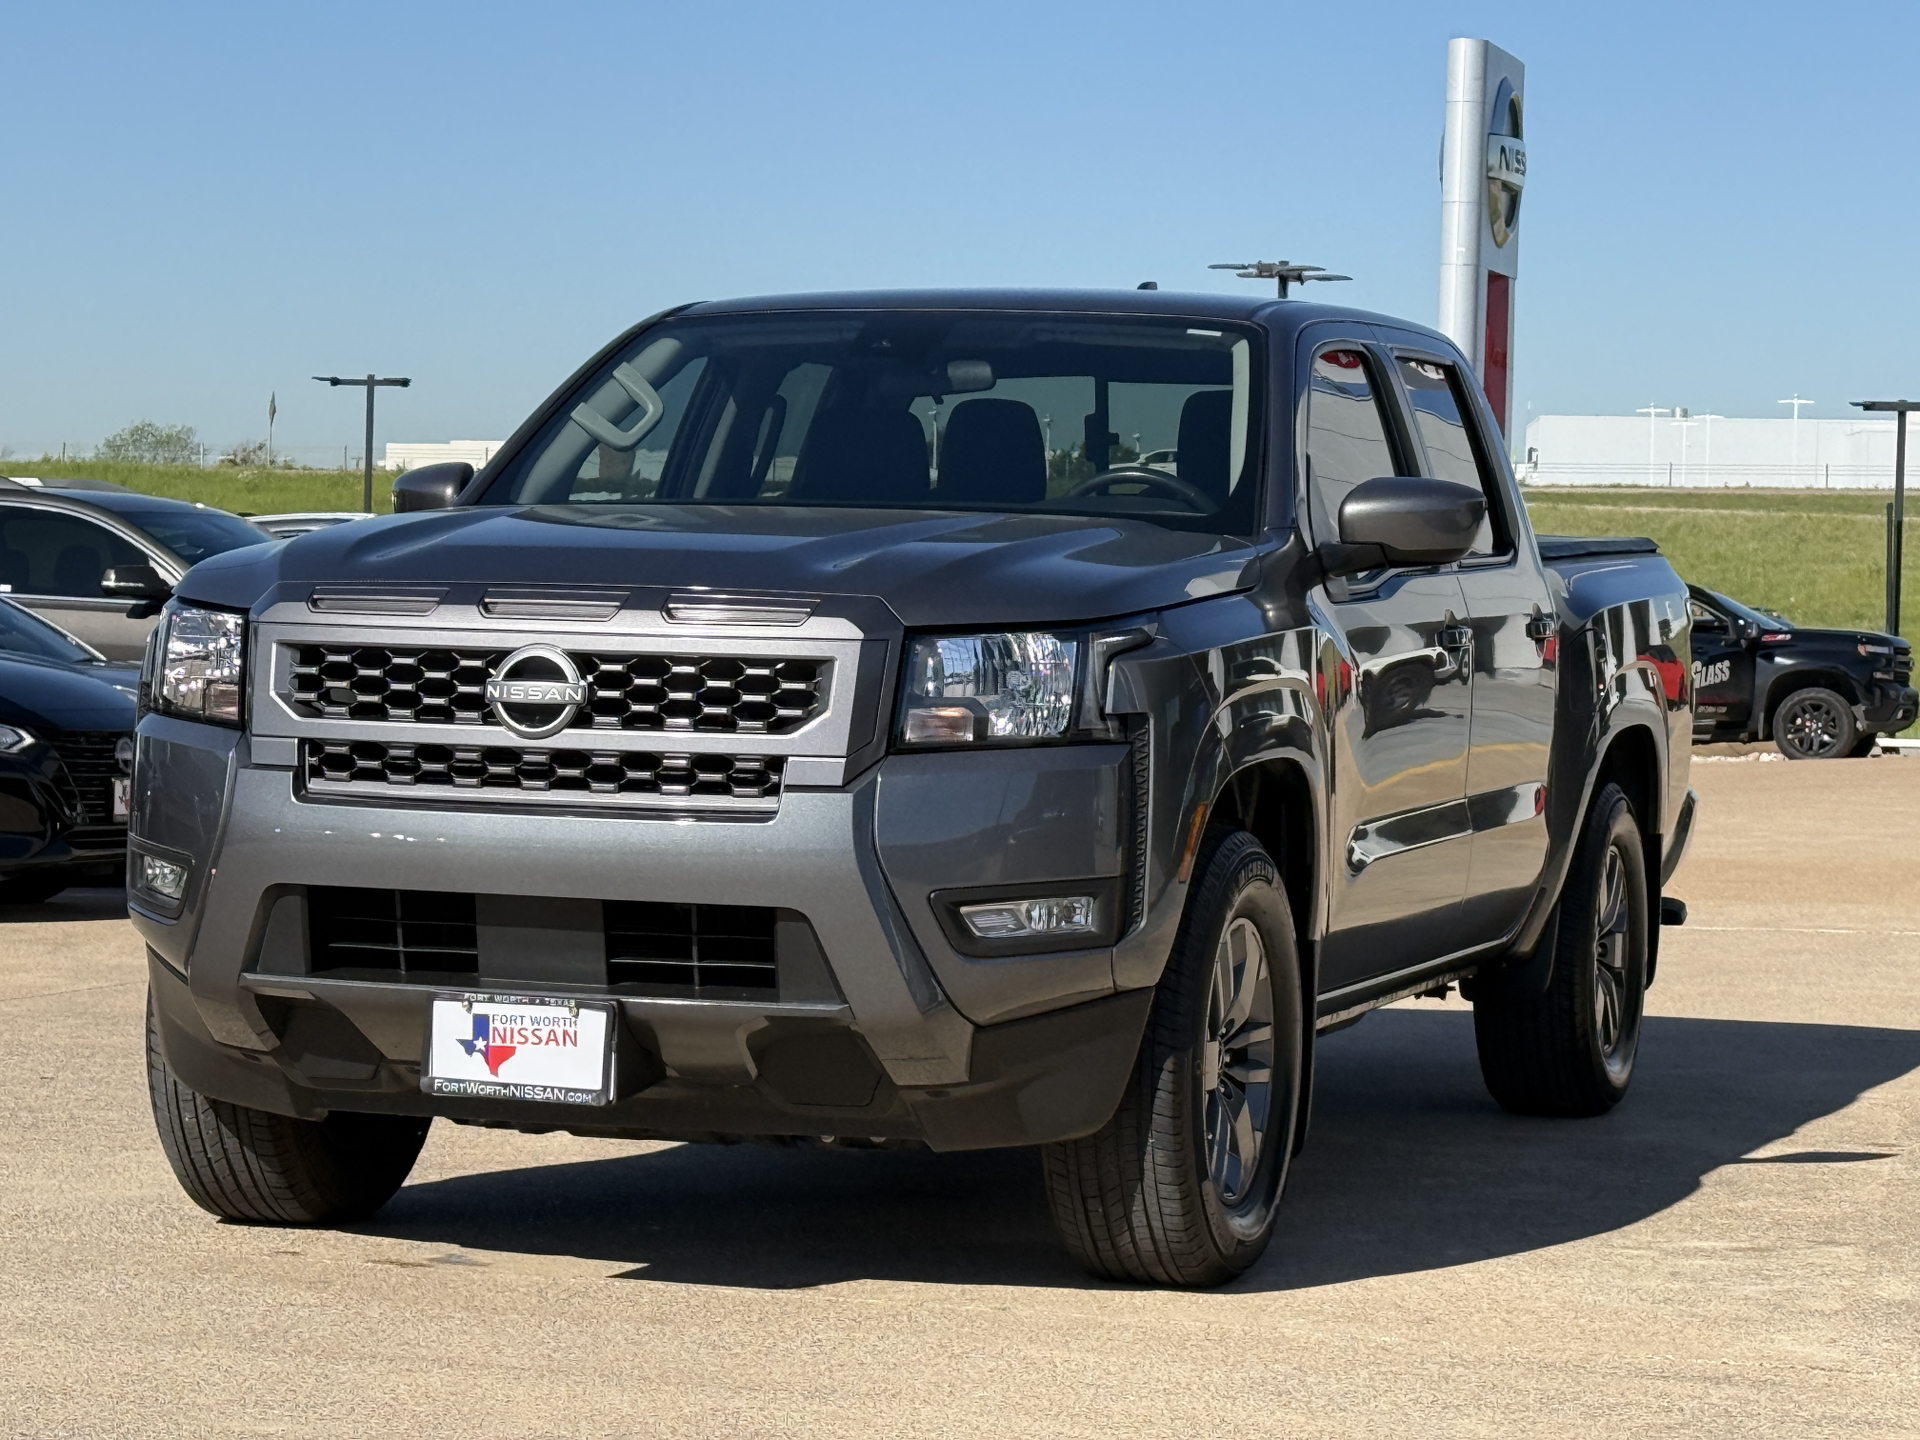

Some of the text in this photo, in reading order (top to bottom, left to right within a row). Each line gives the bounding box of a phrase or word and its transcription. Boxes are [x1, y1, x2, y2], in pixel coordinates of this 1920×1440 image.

[486, 684, 582, 701] NISSAN
[464, 993, 491, 1002] FORT
[494, 994, 529, 1004] WORTH
[492, 1014, 578, 1028] FORT WORTH
[492, 1026, 578, 1047] NISSAN
